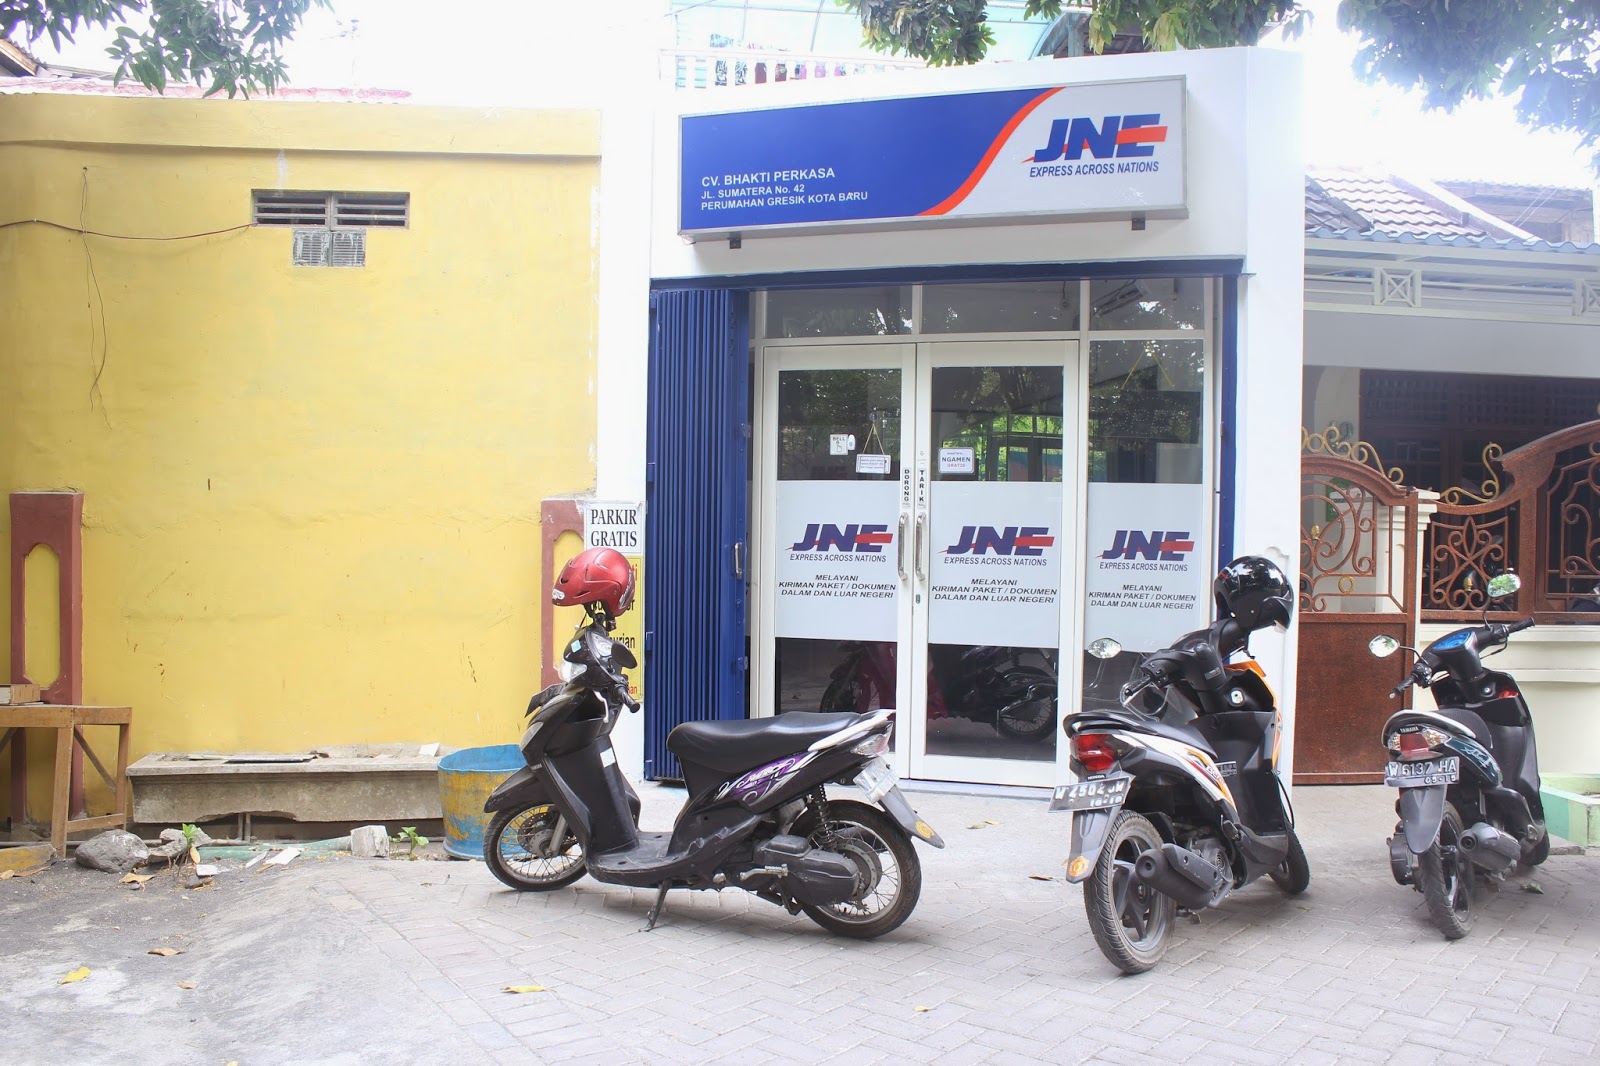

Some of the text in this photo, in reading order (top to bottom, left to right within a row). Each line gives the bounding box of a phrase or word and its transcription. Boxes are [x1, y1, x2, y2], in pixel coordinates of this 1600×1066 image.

[1030, 113, 1168, 163] JNE
[701, 167, 835, 187] CV. BHAKTI PERKASA
[1030, 161, 1159, 178] EXPRESS ACROSS NATIONS
[701, 184, 805, 200] JL. SUMATERA No. 42
[701, 191, 868, 211] PERUMAHAN GRESIK KOTA BARU
[591, 509, 637, 525] PARKIR
[591, 531, 637, 547] GRATIS
[789, 523, 893, 553] JNE
[942, 525, 1055, 556] JNE
[1098, 530, 1195, 561] JNE
[790, 553, 886, 563] EXPRESS ACROSS NATIONS
[944, 556, 1047, 566] EXPRESS ACROSS NATIONS
[1099, 561, 1188, 572] EXPRESS ACROSS NATIONS
[851, 583, 896, 591] DOKUMEN
[932, 585, 970, 593] KIRIMAN
[972, 586, 1003, 594] PAKET
[1010, 587, 1057, 595] DOKUMEN
[971, 578, 1018, 586] MELAYANI
[1122, 584, 1162, 592] MELAYANI
[934, 593, 967, 601] DALAM
[969, 594, 989, 602] DAN
[1089, 591, 1121, 599] KIRIMAN
[1123, 592, 1150, 600] PAKET
[1155, 593, 1196, 601] DOKUMEN
[1120, 600, 1138, 608] DAN
[1139, 601, 1161, 609] LUAR
[1163, 602, 1193, 610] NEGERI
[1388, 759, 1457, 777] W 6137 HA
